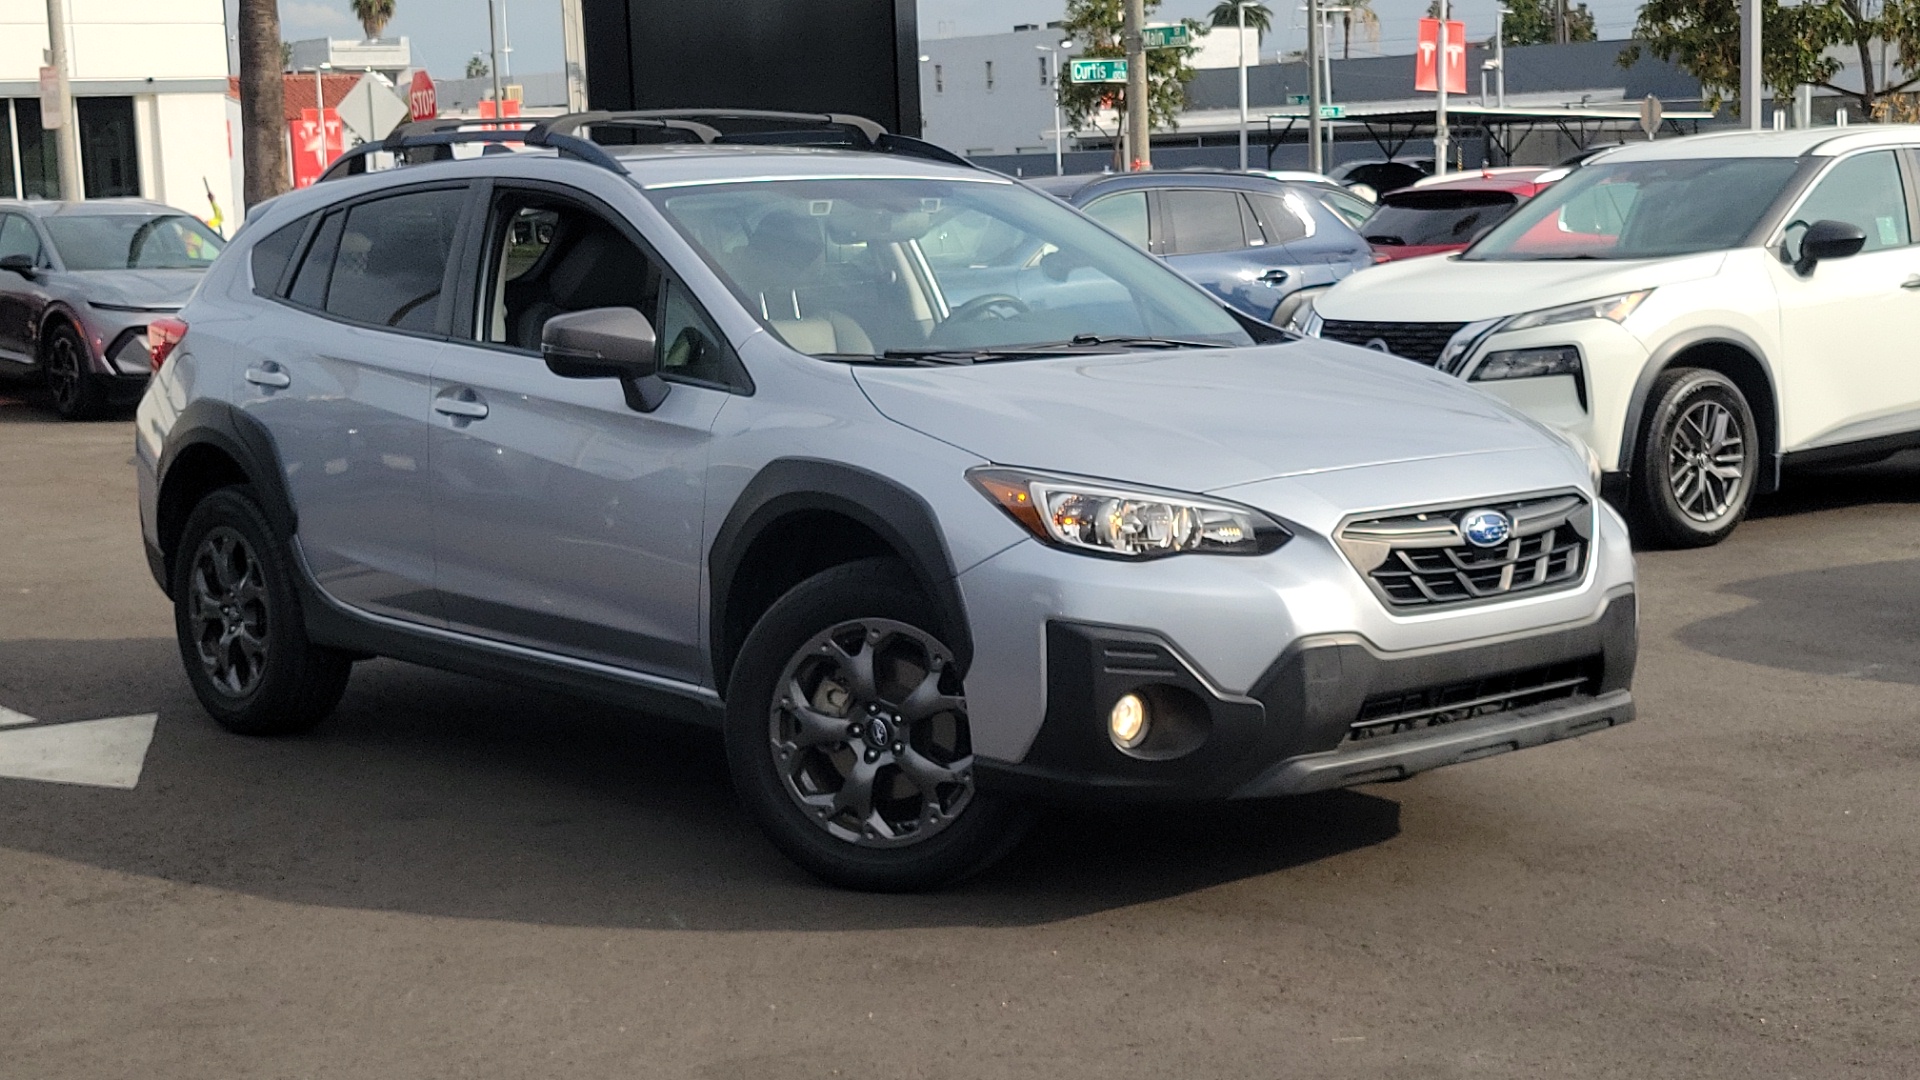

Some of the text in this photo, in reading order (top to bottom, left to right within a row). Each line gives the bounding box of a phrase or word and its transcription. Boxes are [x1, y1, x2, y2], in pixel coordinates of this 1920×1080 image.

[1143, 30, 1165, 46] Main
[1074, 63, 1107, 79] Curtis
[411, 90, 435, 117] STOP
